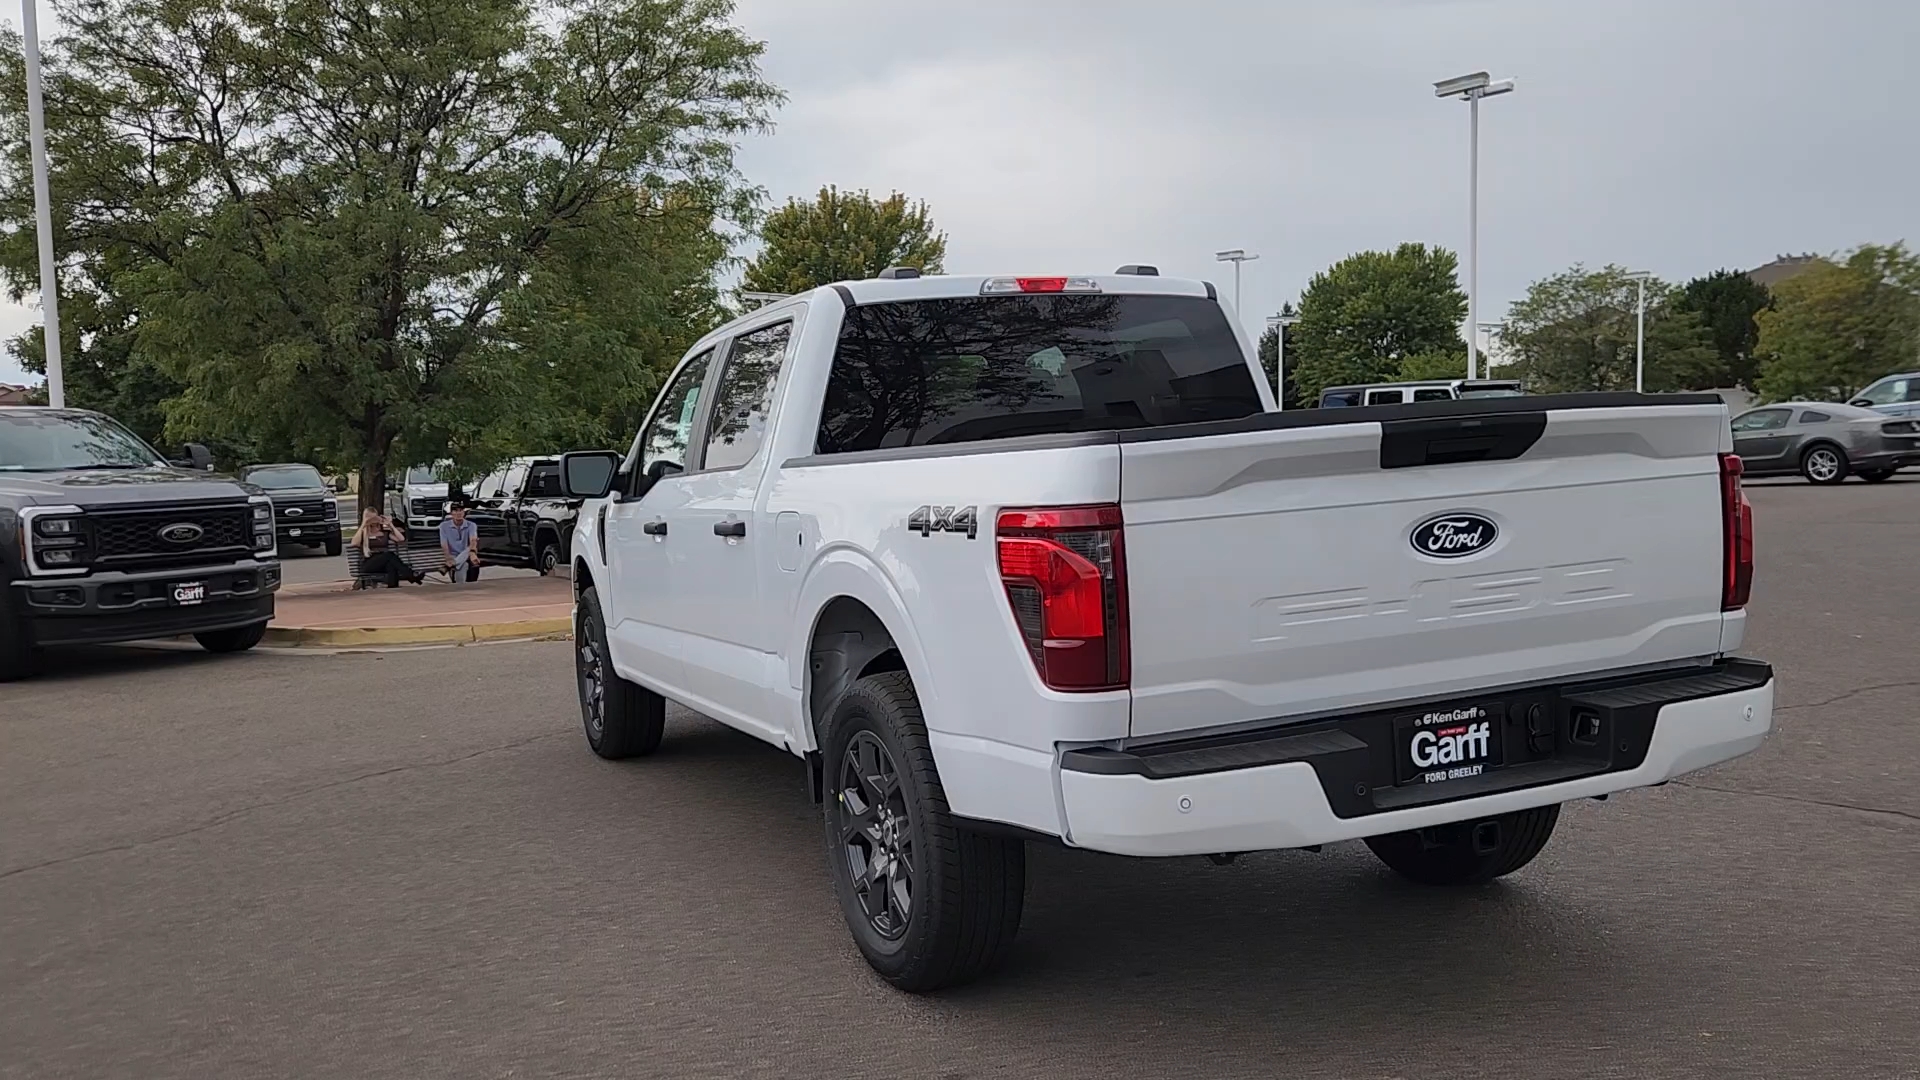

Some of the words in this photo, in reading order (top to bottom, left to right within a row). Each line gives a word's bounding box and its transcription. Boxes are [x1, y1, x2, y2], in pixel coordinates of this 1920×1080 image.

[172, 528, 194, 539] Ford
[428, 521, 483, 550] Ford
[174, 586, 204, 601] Garff
[1432, 712, 1453, 724] Ken
[1453, 707, 1477, 720] Garff
[1410, 721, 1490, 768] Garff
[1425, 772, 1447, 783] FORD
[1448, 765, 1483, 779] GREELEY
